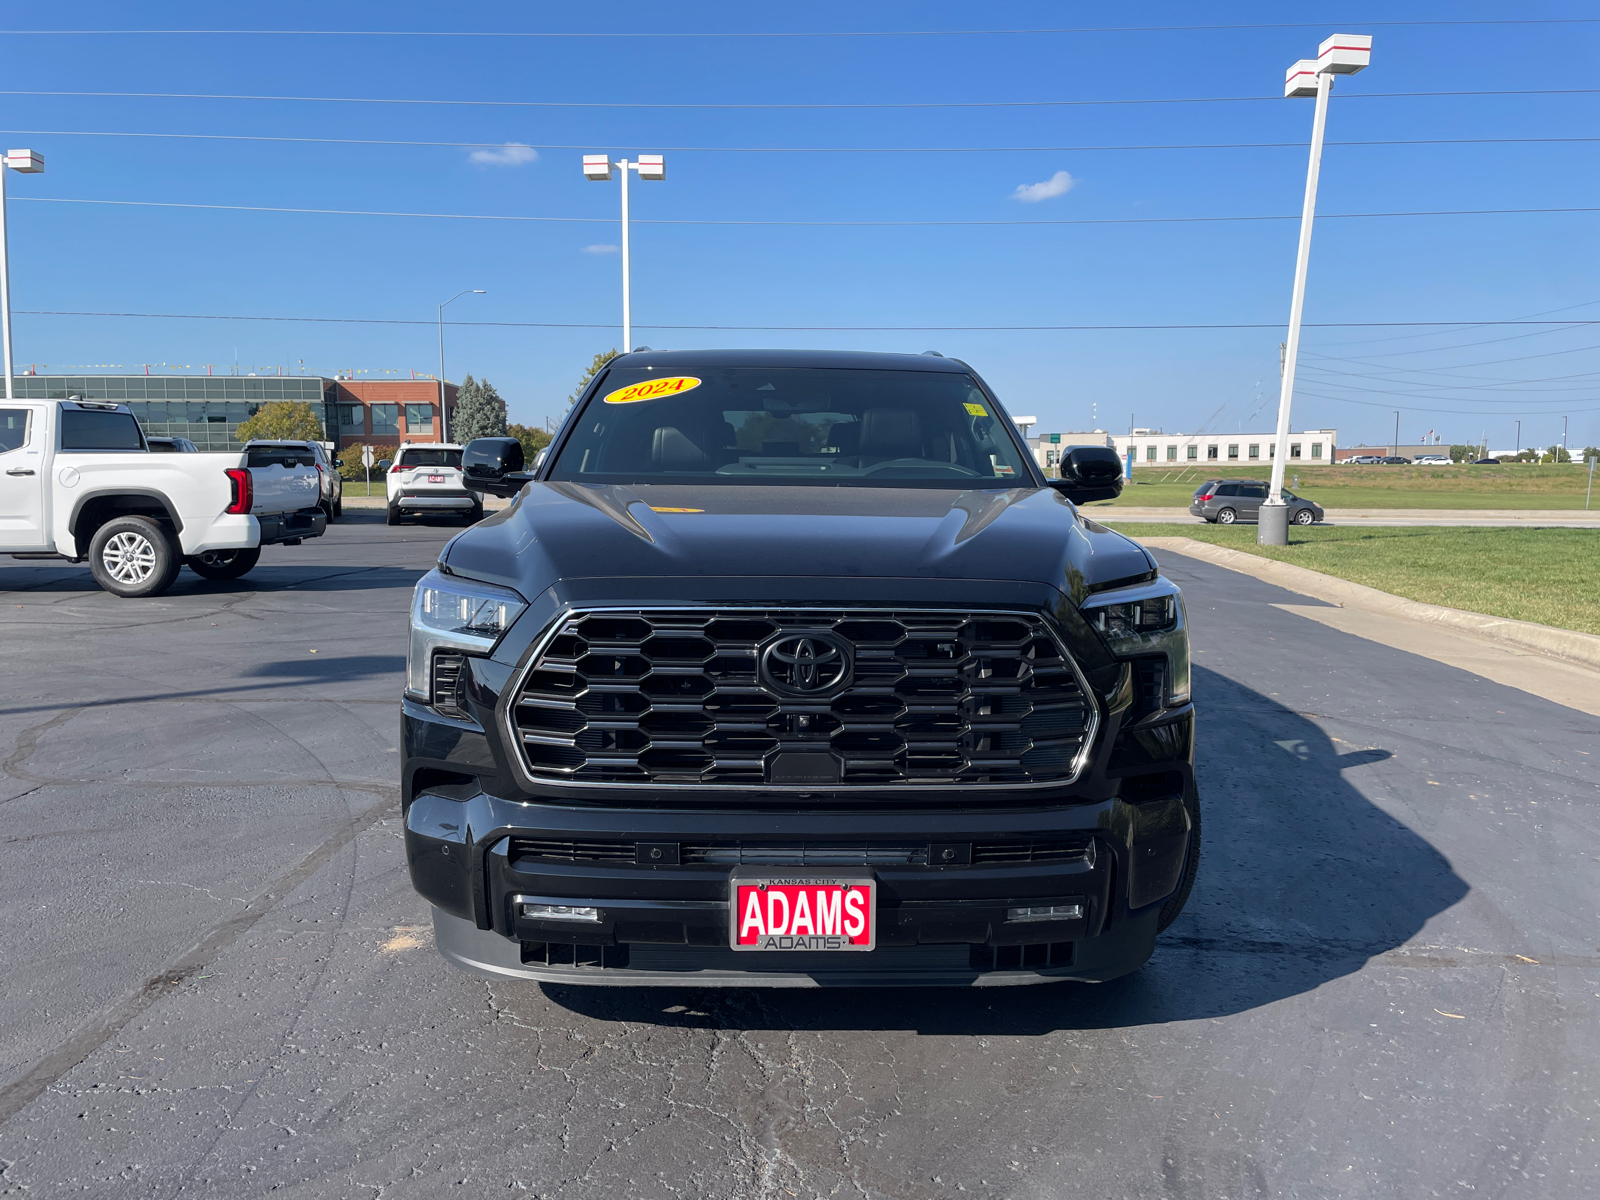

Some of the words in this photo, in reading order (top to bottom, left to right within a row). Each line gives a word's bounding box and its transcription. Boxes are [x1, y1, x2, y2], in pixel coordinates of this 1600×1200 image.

[620, 379, 684, 401] 2024
[742, 890, 865, 937] ADAMS
[764, 937, 841, 949] ADAMS
